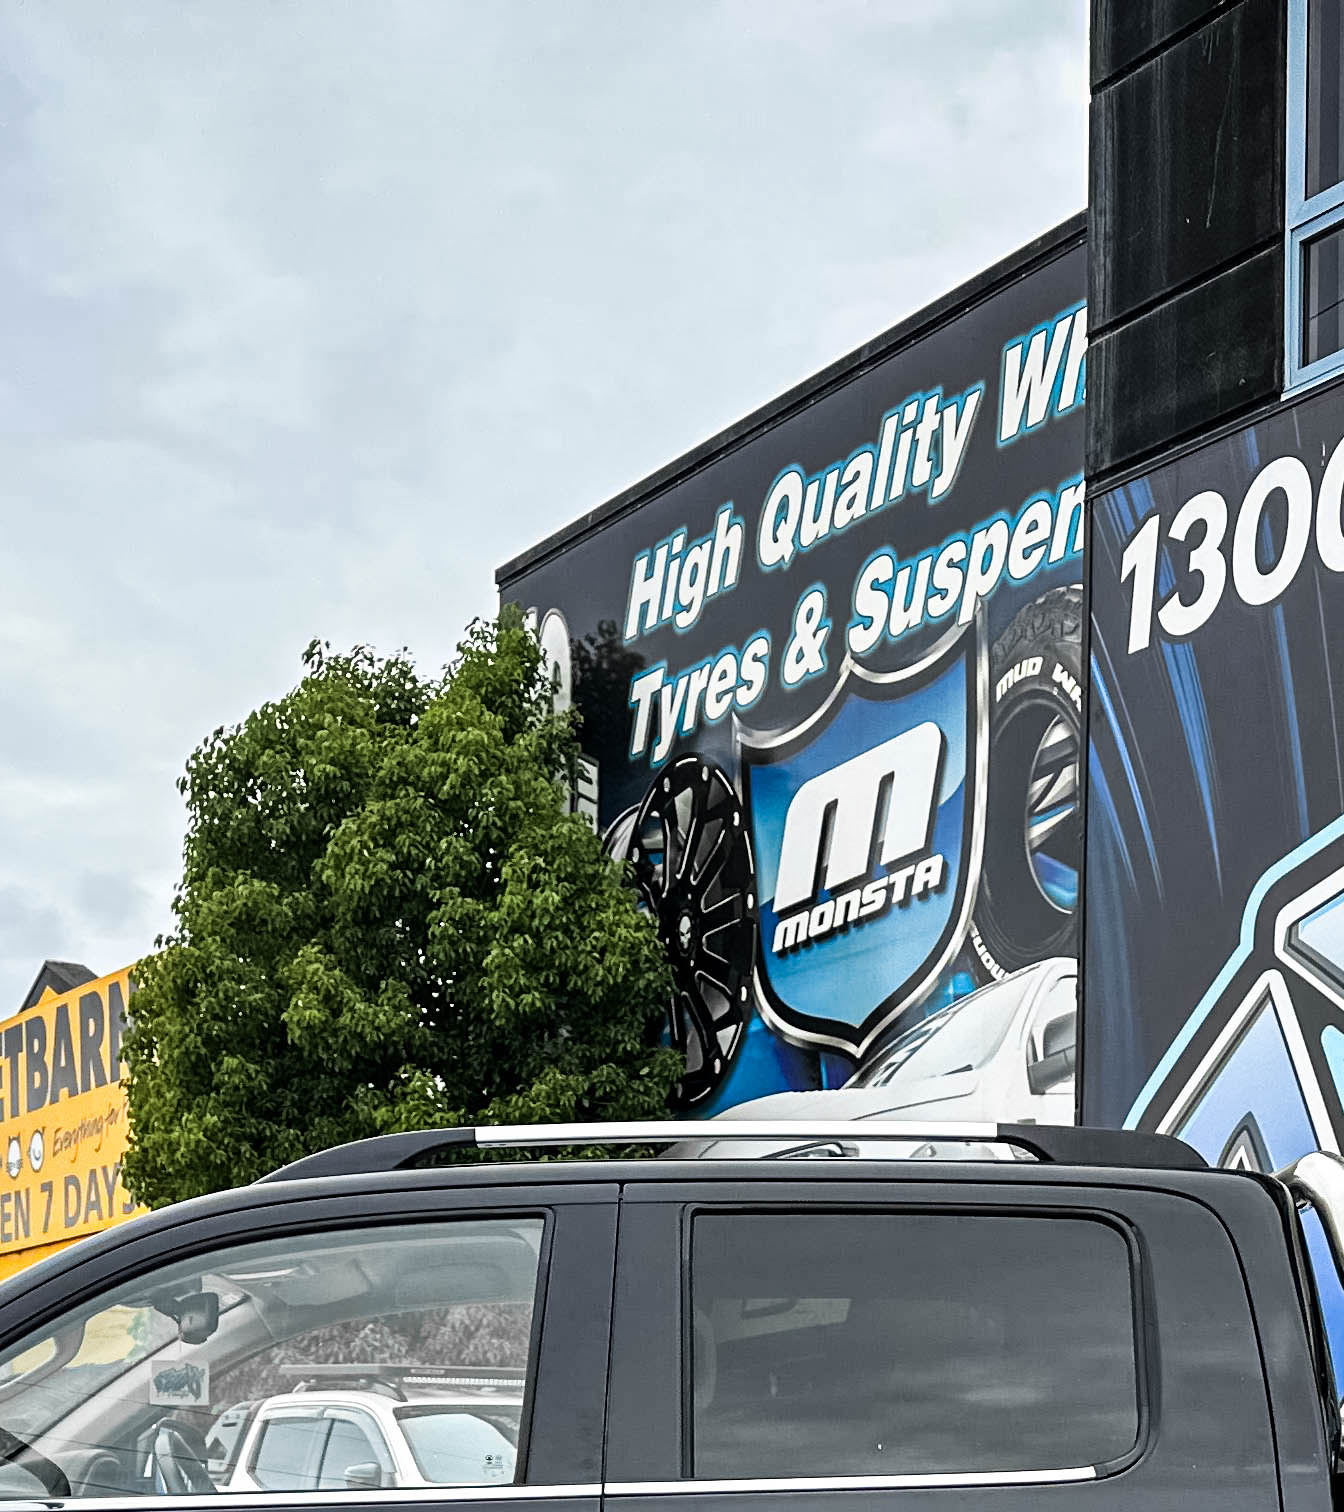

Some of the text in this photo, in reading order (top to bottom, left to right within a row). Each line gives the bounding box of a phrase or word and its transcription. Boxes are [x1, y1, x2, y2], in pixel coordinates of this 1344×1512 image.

[623, 508, 744, 640] High
[758, 388, 982, 568] Quality
[630, 636, 770, 763] Tyres
[783, 590, 832, 685] &
[847, 480, 1085, 654] Suspen
[996, 656, 1044, 703] MUD
[771, 853, 944, 953] MONSTA
[40, 1180, 54, 1234] 7
